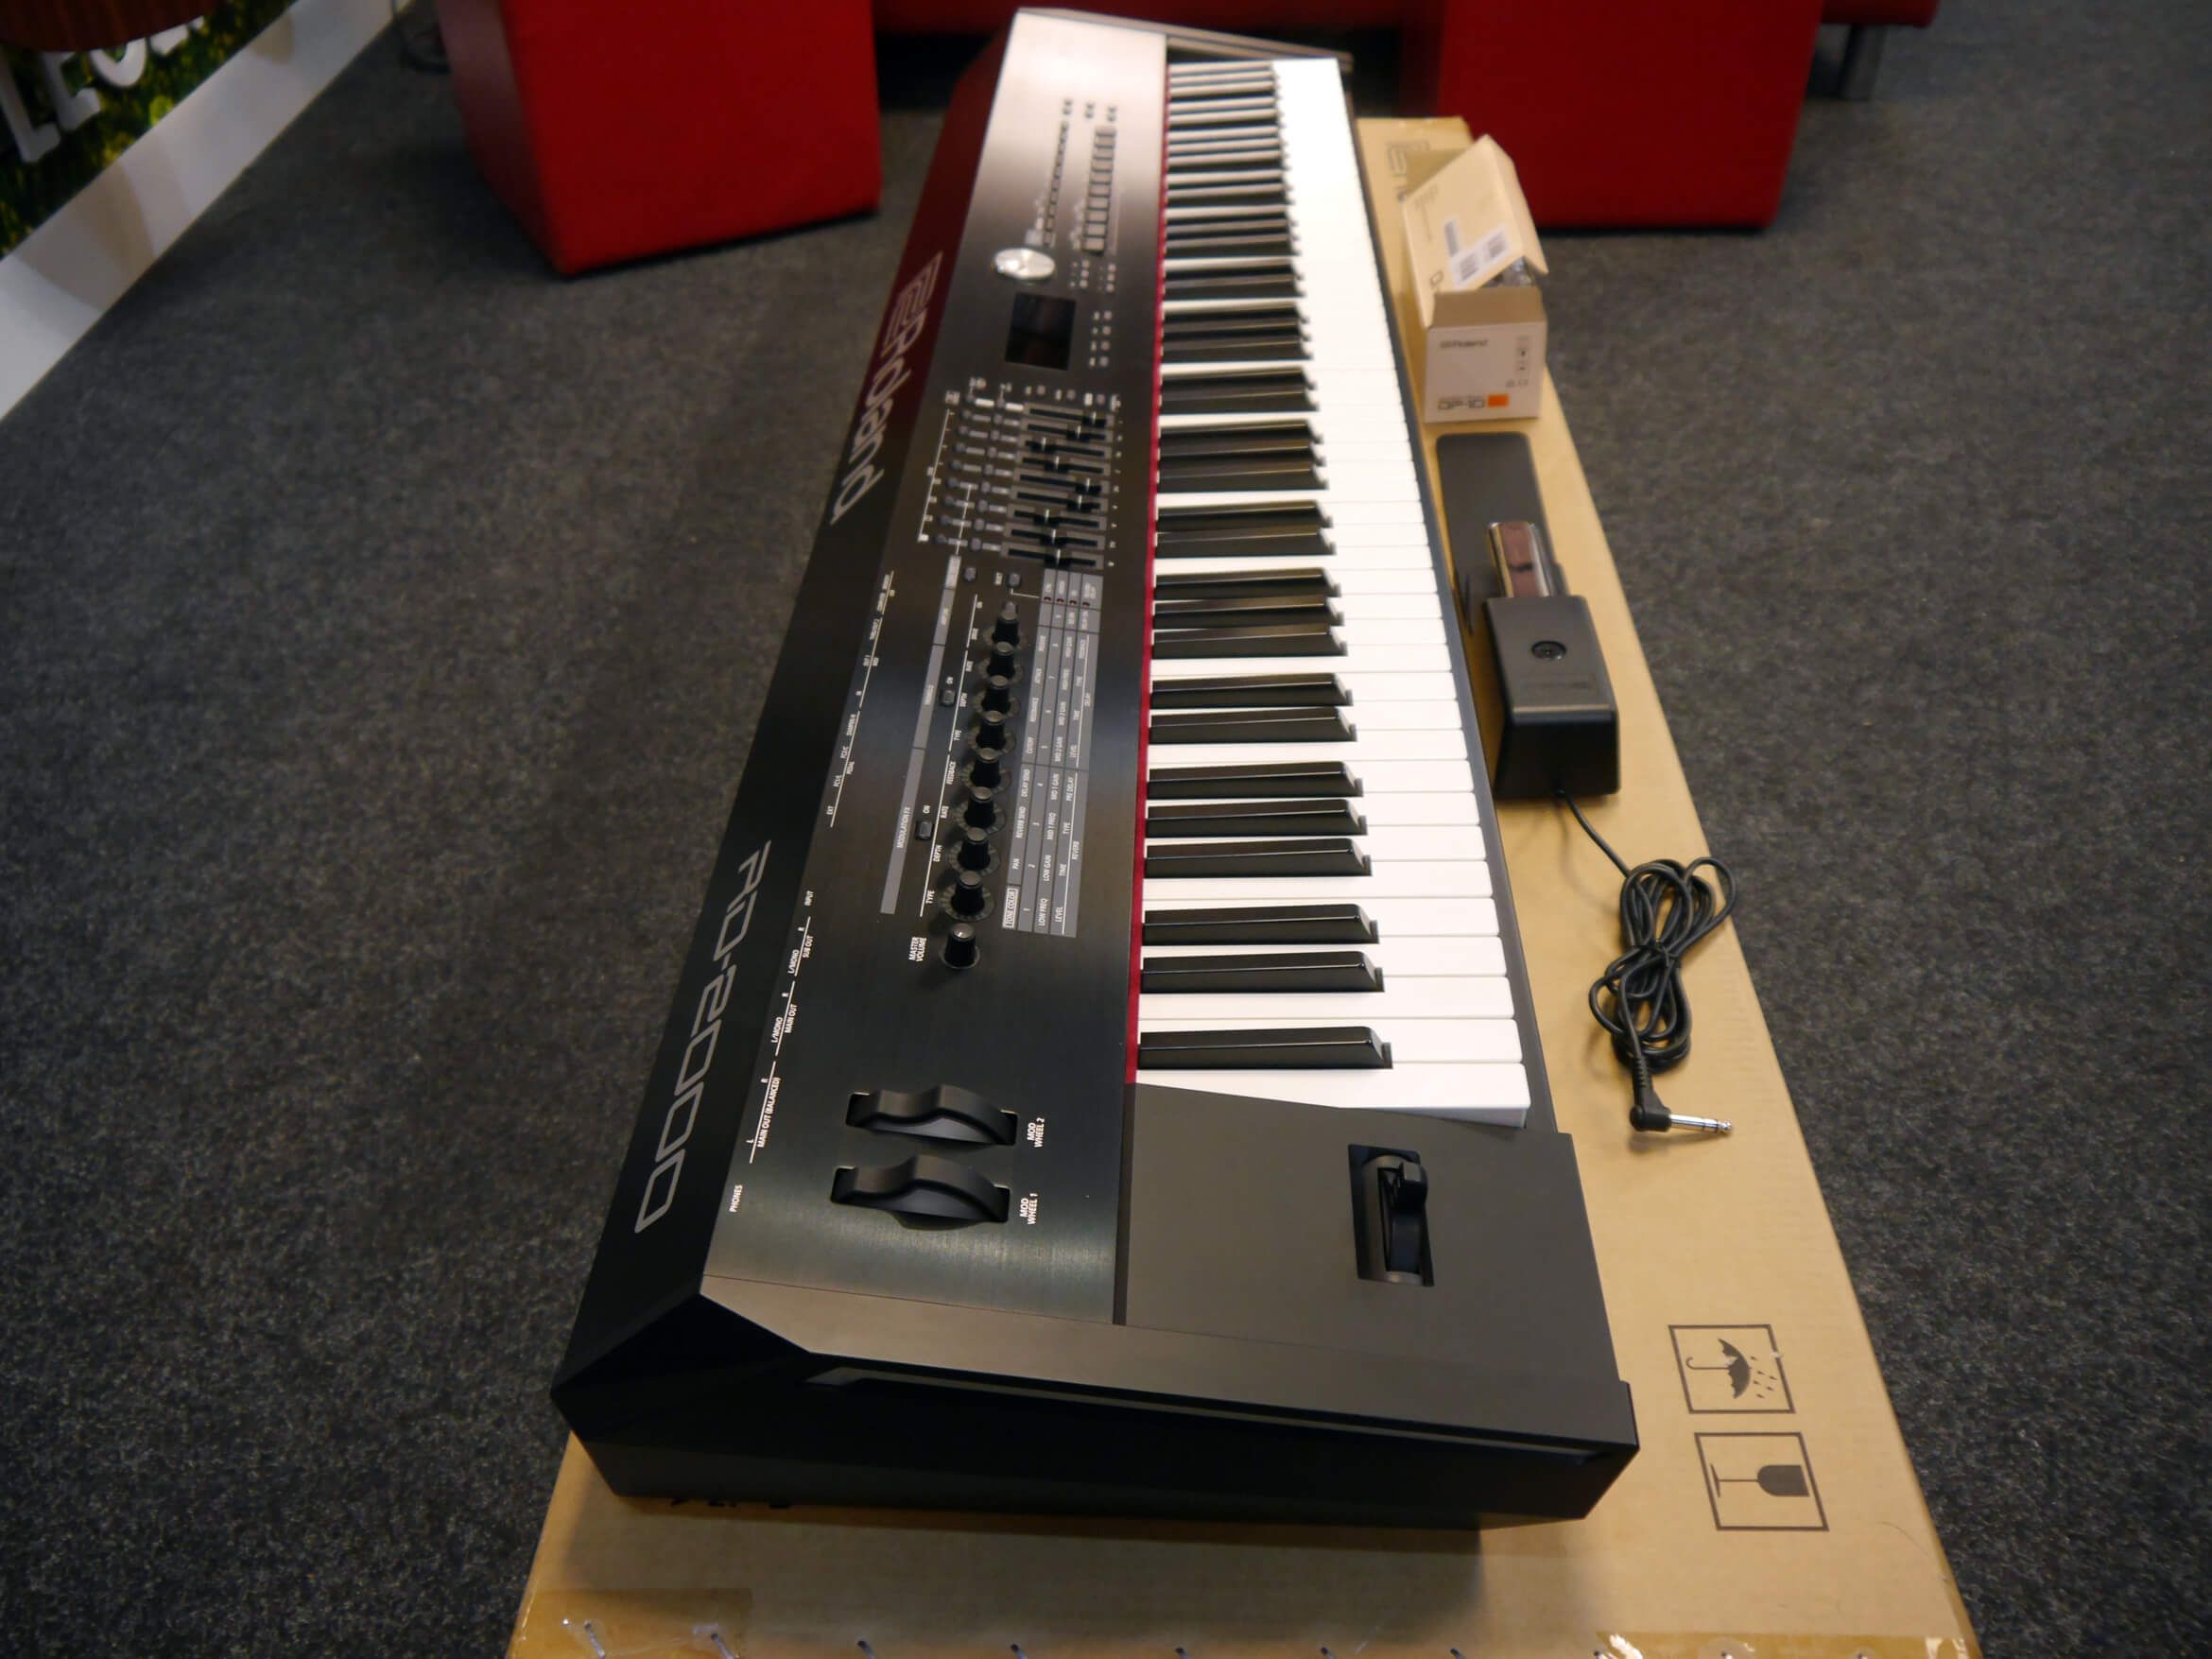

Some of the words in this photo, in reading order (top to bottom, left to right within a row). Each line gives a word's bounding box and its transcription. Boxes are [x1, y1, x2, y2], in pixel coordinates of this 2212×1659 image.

[831, 306, 927, 526] Roland
[946, 761, 957, 785] FEEDBACK
[923, 804, 930, 813] ON
[941, 805, 949, 819] RATE
[897, 815, 909, 848] MODULATION
[1015, 820, 1024, 838] REVERB
[933, 844, 942, 862] DEPTH
[1071, 840, 1080, 860] REVERB
[1011, 858, 1020, 870] PAN
[804, 890, 814, 906] INPUT
[925, 890, 935, 904] TYPE
[1040, 898, 1048, 912] FREQ
[1055, 907, 1063, 923] LEVEL
[803, 947, 811, 958] SUB
[908, 936, 920, 960] MASTER
[916, 937, 927, 961] VOLUME
[787, 949, 800, 974] L/MONO
[788, 1004, 798, 1016] OUT
[771, 1016, 783, 1043] L/MONO
[785, 1017, 795, 1033] MAIN
[634, 840, 771, 1233] RD-2000
[765, 1077, 781, 1115] (BALANCED)
[762, 1115, 771, 1128] OUT
[757, 1129, 769, 1148] MAIN
[1027, 1122, 1036, 1141] MOD
[1034, 1124, 1045, 1148] WHEEL
[729, 1184, 743, 1213] PHONES
[1019, 1198, 1029, 1218] MOD
[1028, 1199, 1038, 1225] WHEEL
